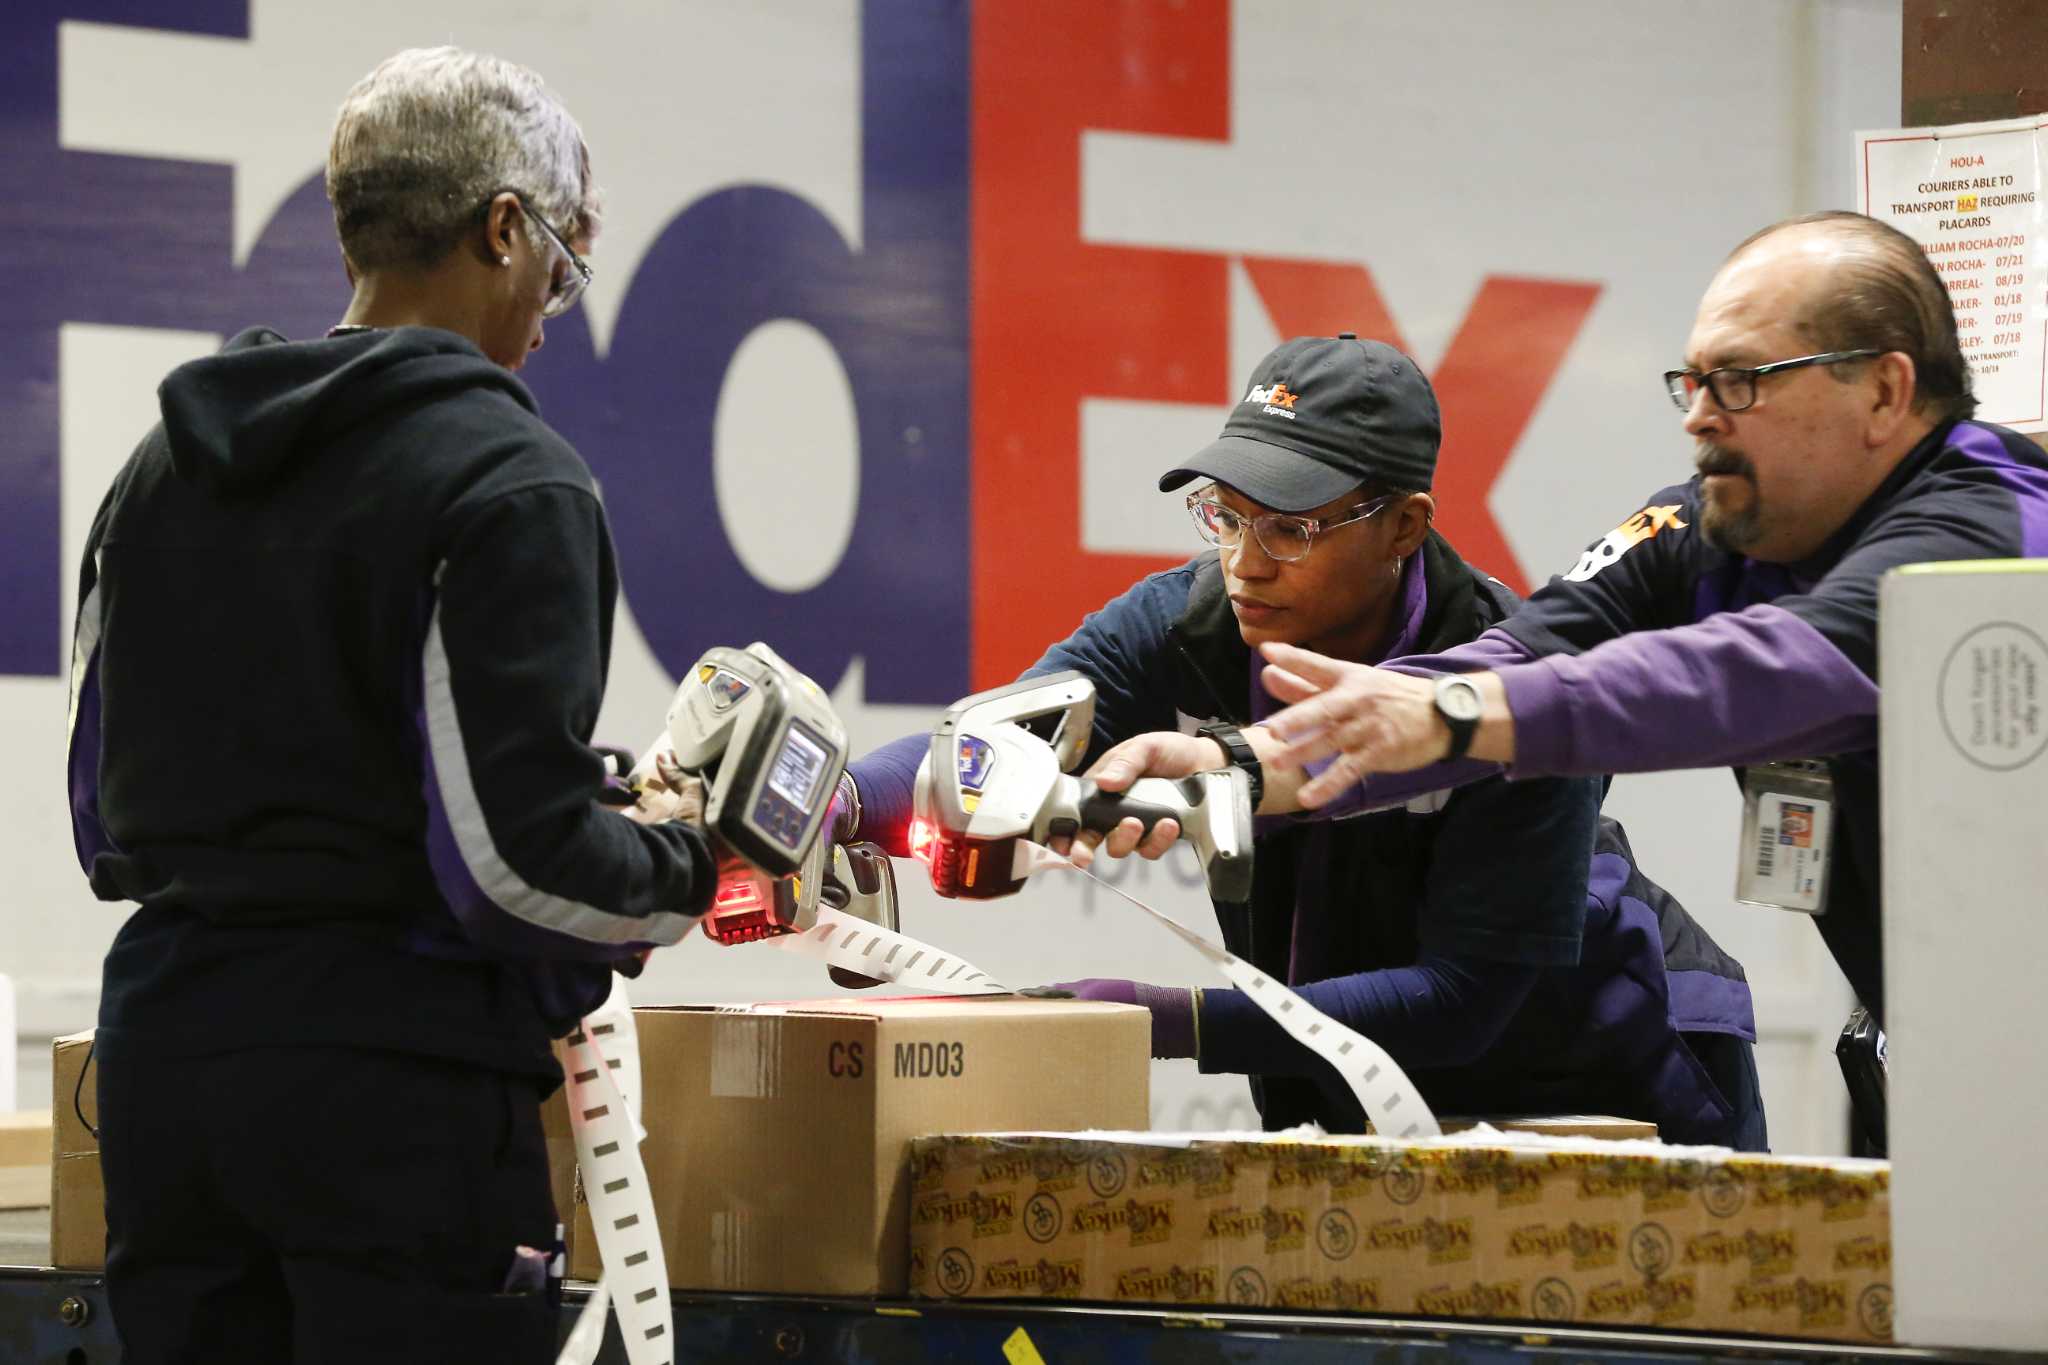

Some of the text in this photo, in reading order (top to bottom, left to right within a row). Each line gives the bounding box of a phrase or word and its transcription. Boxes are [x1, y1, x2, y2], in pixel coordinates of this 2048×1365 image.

[1949, 154, 1985, 169] HOU-A
[1917, 175, 2014, 194] COURIERS ABLE TO
[1890, 192, 2036, 215] TRANSPORT HAZ REQUIRING
[1938, 216, 1992, 231] PLACARDS
[1947, 258, 1987, 272] ROCHA-
[1995, 255, 2024, 268] 07/21
[1995, 274, 2024, 287] 08/19
[1993, 294, 2022, 308] 01/18
[1994, 313, 2023, 327] 07/19
[1993, 332, 2021, 346] 07/18
[1245, 384, 1300, 408] FedEx
[1262, 403, 1297, 420] Express
[828, 1040, 864, 1079] CS
[894, 1041, 965, 1079] MD03
